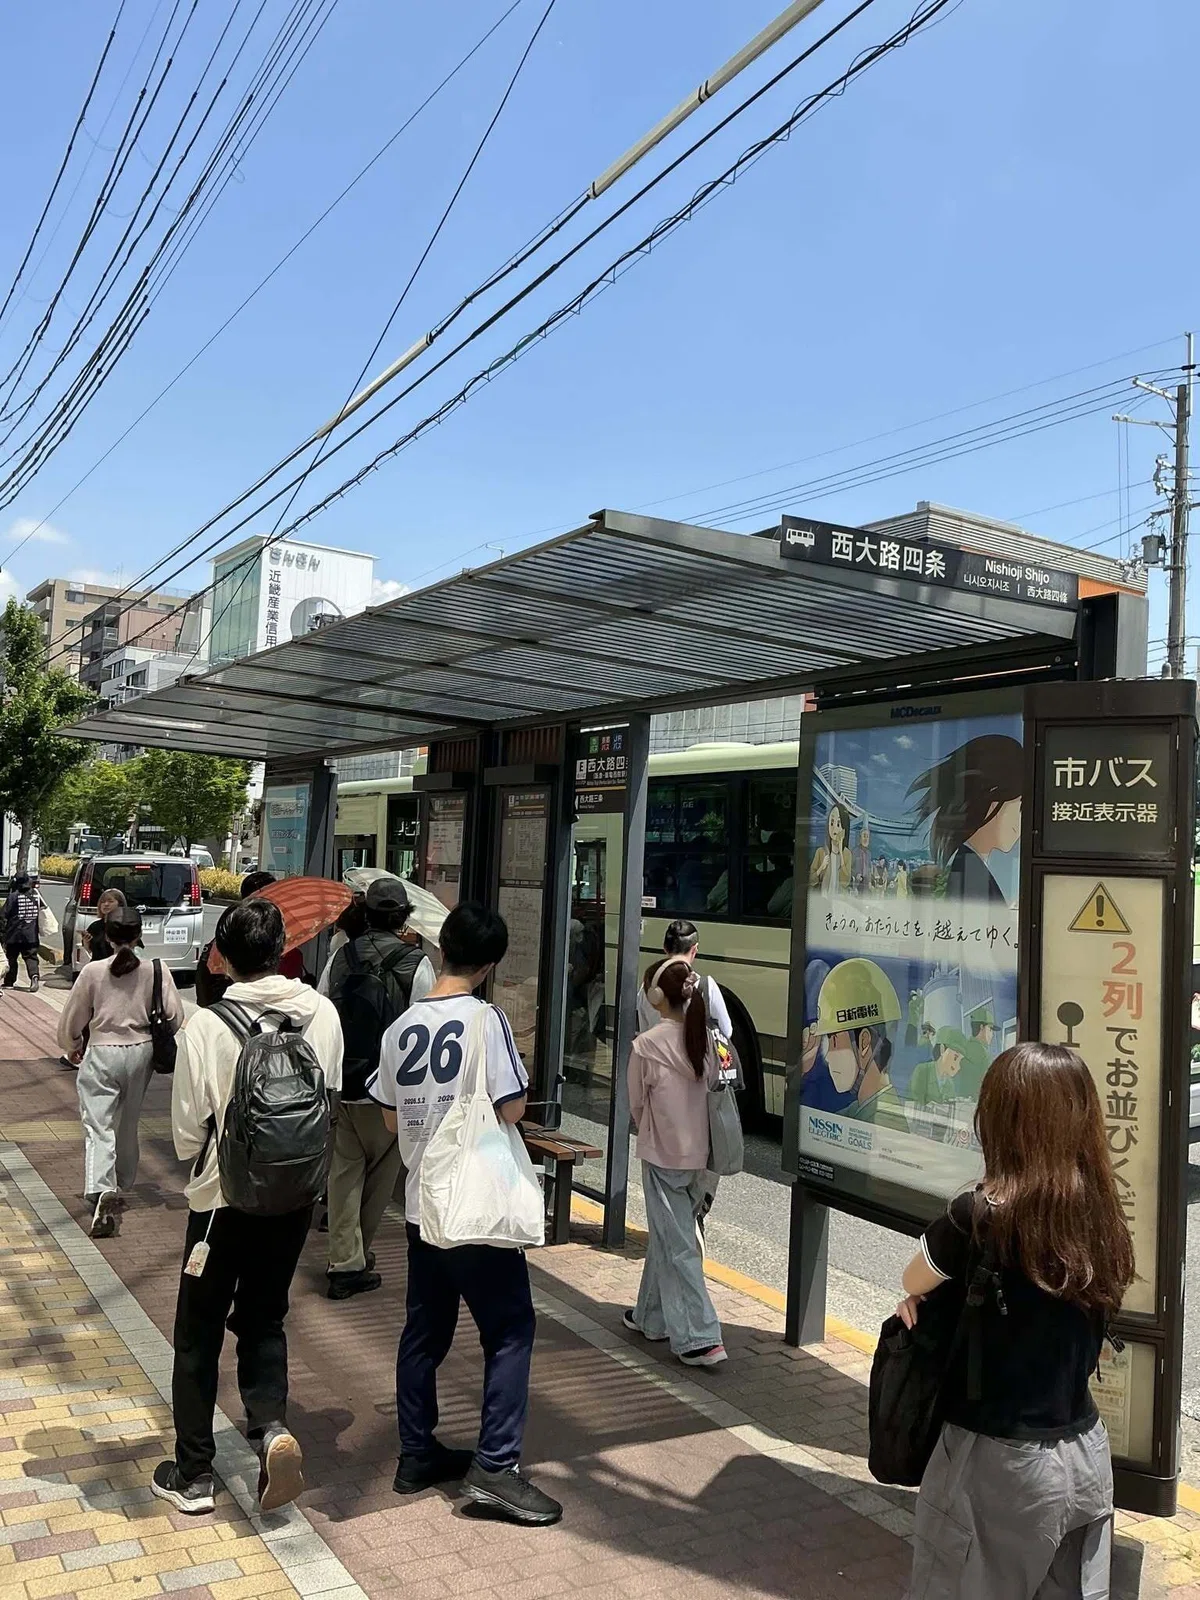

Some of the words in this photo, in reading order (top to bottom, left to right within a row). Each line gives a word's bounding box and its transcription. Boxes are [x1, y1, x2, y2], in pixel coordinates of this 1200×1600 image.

[831, 530, 946, 578] 西大路四条
[985, 560, 1022, 581] Nishioji
[1024, 567, 1050, 585] Shijo
[963, 573, 1010, 592] 니시오지시조
[1027, 585, 1068, 604] 西大路四條
[264, 570, 281, 647] 近畿産業信用
[588, 756, 629, 772] 西大路四
[1053, 757, 1158, 789] 市バス
[1051, 802, 1158, 823] 接近表示器
[836, 1003, 879, 1023] 日新電機
[396, 1019, 465, 1087] 26
[808, 1116, 843, 1134] NISSIN
[808, 1126, 842, 1143] ELECTRIC
[847, 1136, 872, 1150] GOALS
